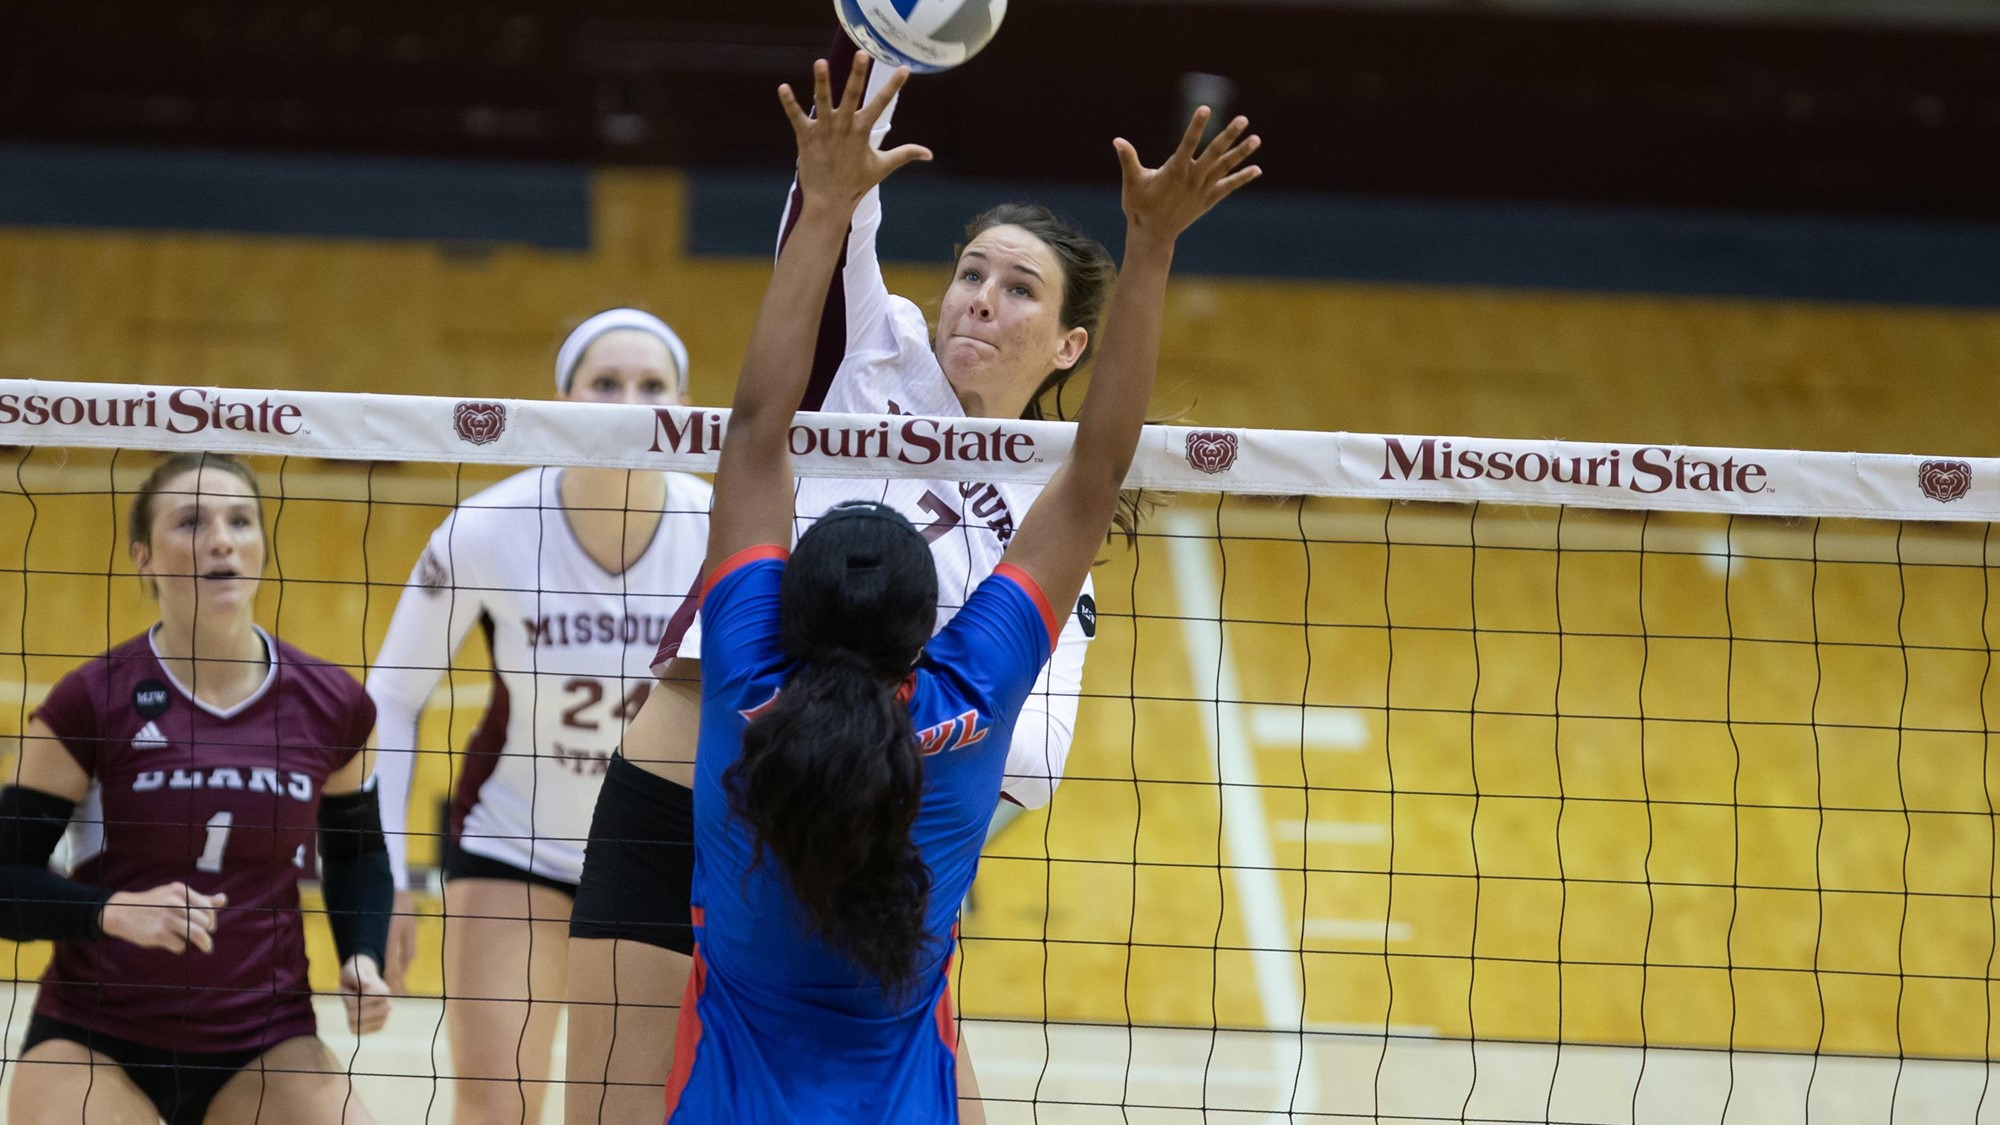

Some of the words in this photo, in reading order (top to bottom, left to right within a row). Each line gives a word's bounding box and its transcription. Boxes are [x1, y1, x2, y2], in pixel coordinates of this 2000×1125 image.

[166, 388, 302, 435] State
[647, 408, 889, 459] Miouri
[897, 418, 1035, 465] State
[1379, 437, 1622, 488] Missouri
[1629, 447, 1768, 494] State
[916, 489, 961, 545] 7
[196, 811, 234, 873] 1
